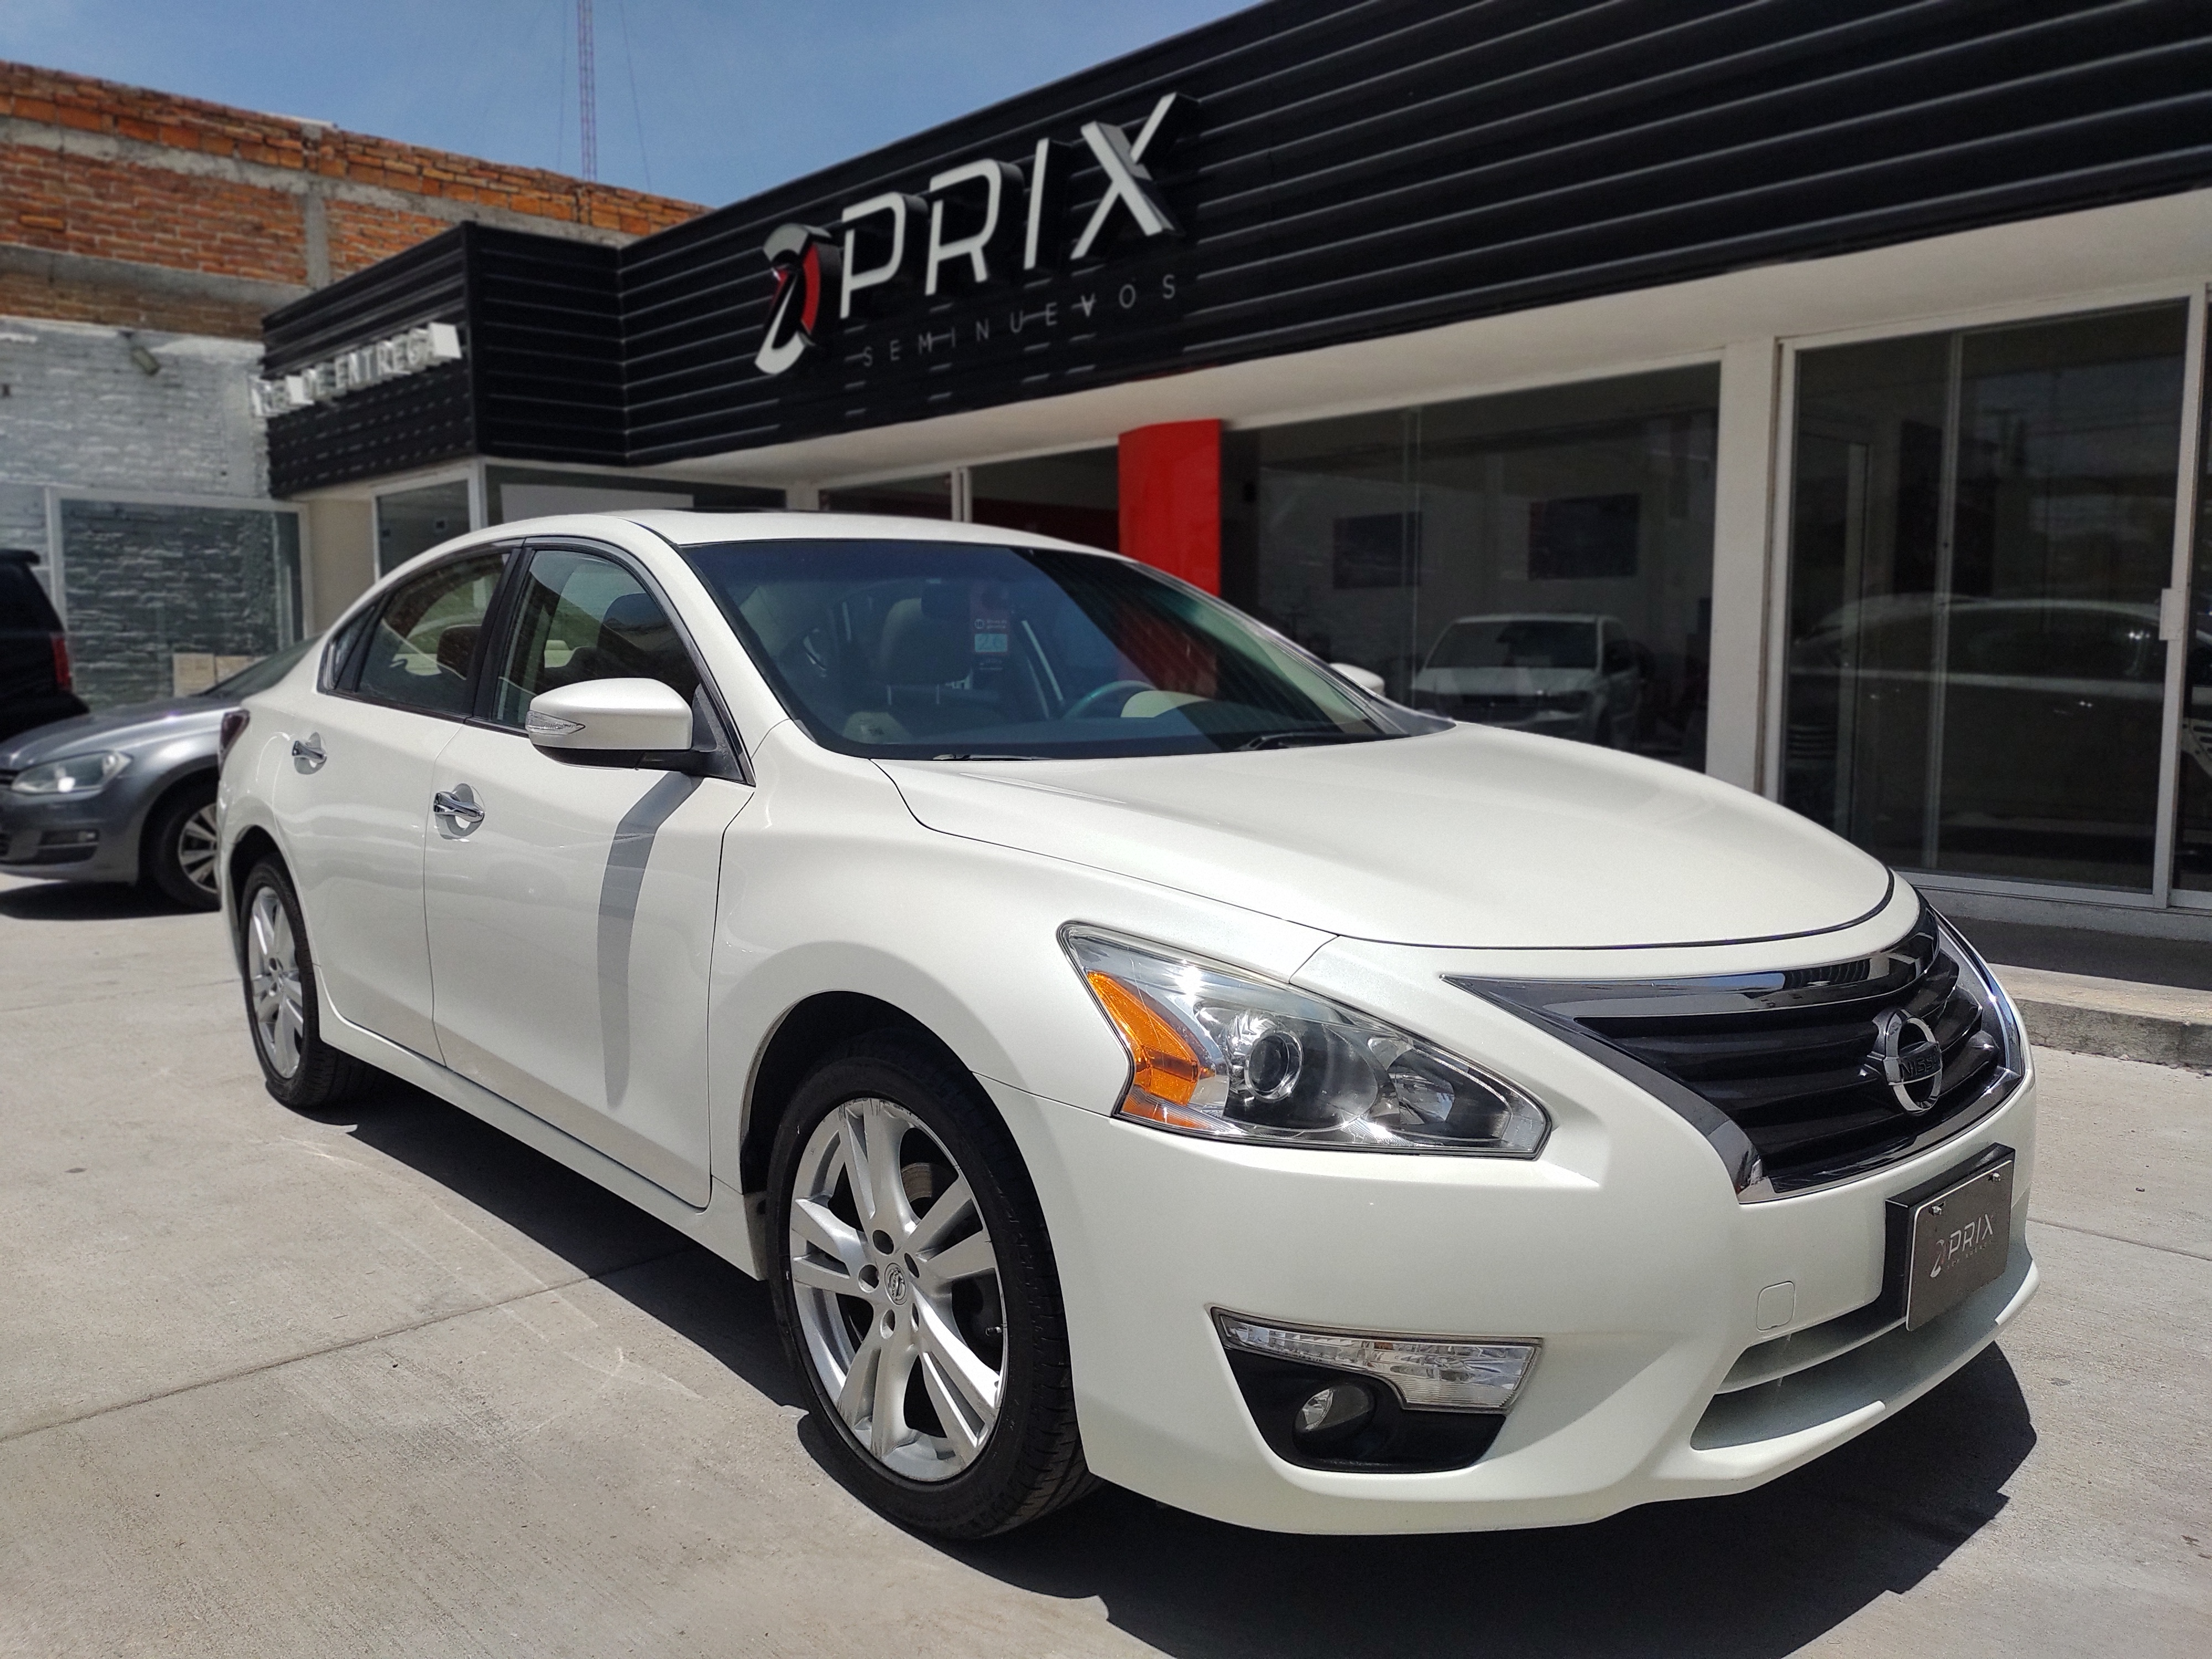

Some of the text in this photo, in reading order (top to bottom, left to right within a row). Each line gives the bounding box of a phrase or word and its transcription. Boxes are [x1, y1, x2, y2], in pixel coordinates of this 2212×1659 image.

[839, 92, 1180, 319] PRIX
[863, 274, 1176, 367] SEMINUEVOS
[1900, 1053, 1941, 1081] NISS
[1948, 1213, 1994, 1260] PRIX
